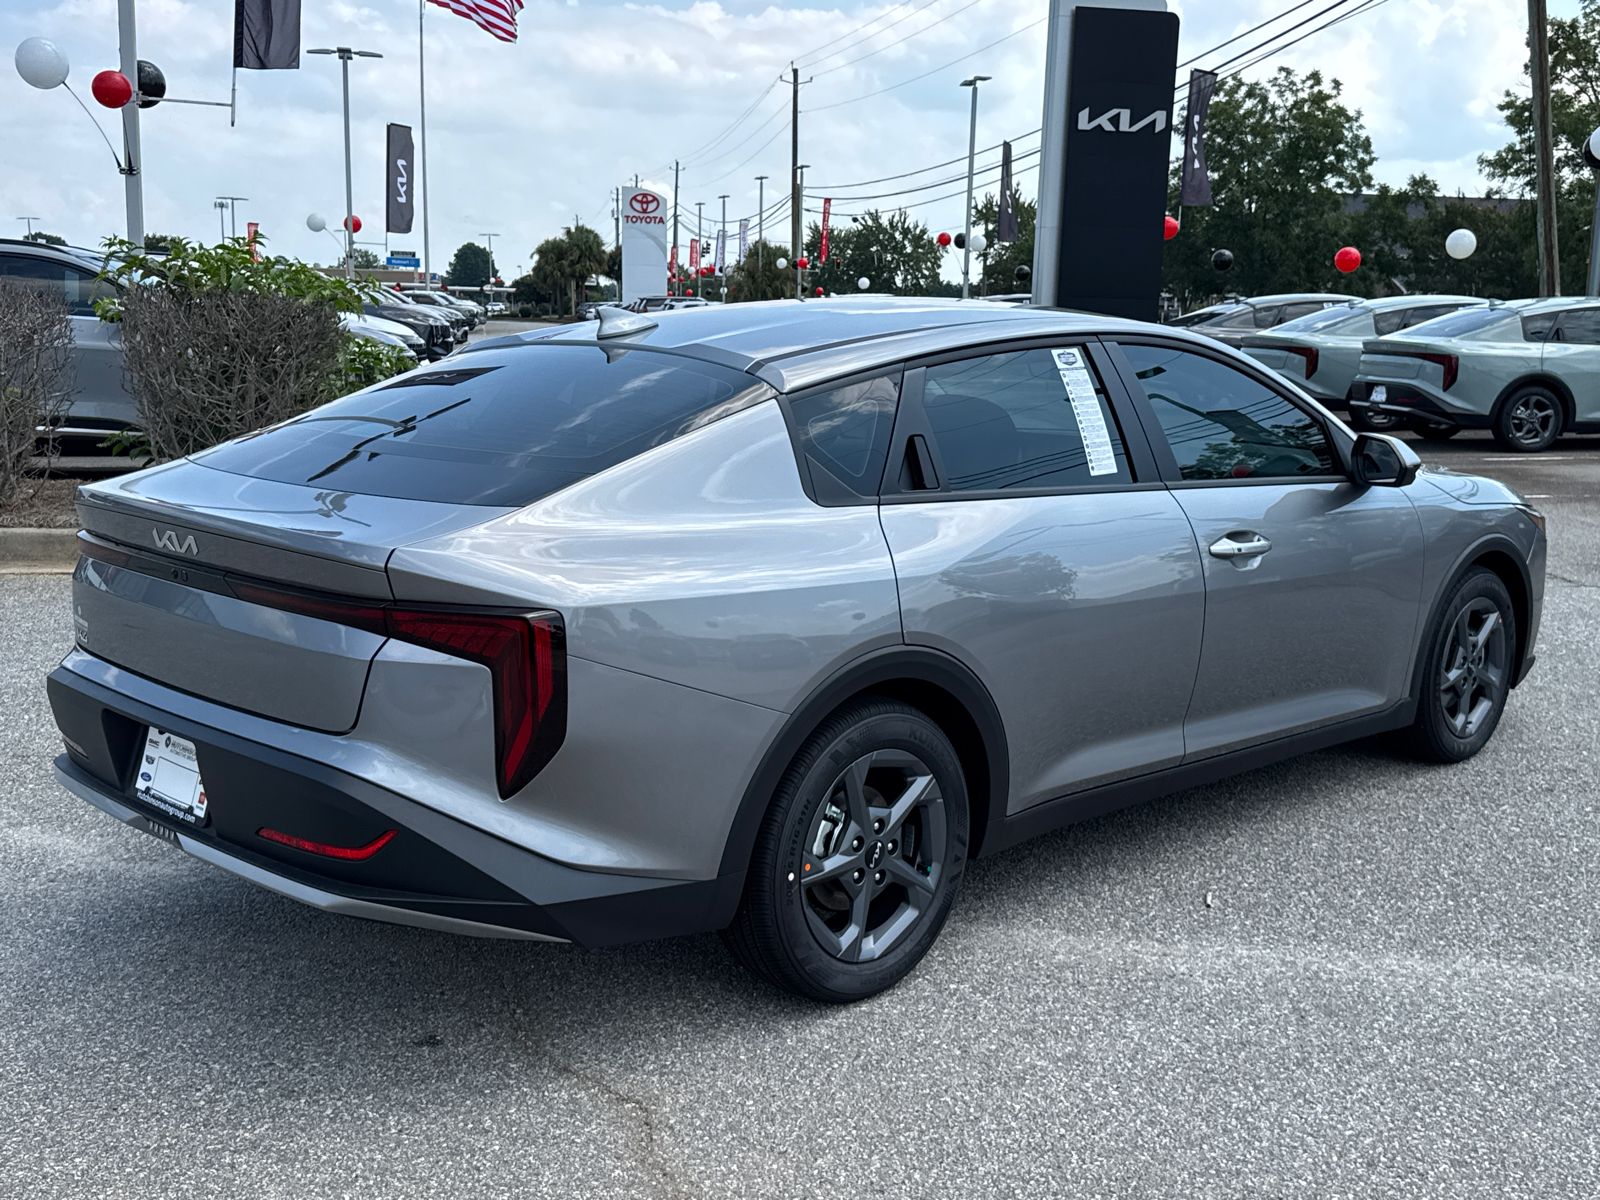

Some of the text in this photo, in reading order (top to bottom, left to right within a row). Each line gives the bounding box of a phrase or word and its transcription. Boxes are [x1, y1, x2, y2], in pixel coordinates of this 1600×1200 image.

[1077, 106, 1168, 134] KIA
[624, 215, 665, 225] TOYOTA
[152, 527, 199, 556] KIA
